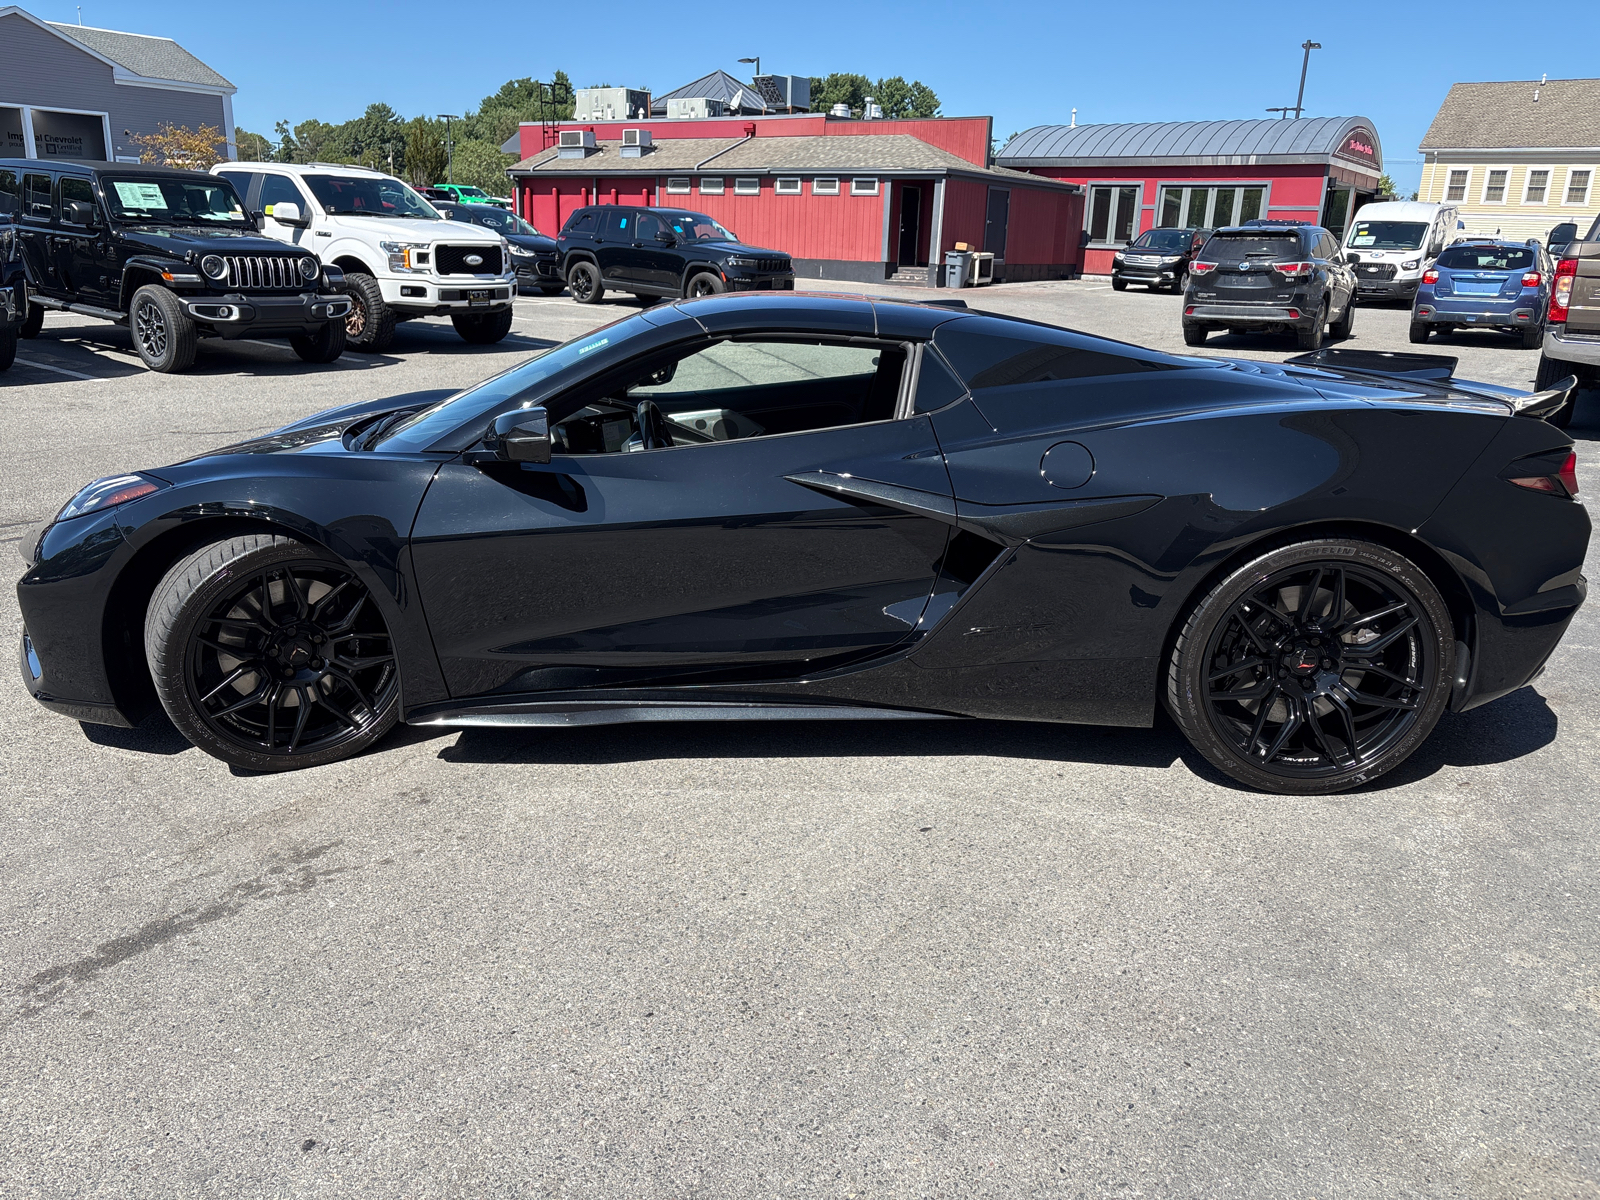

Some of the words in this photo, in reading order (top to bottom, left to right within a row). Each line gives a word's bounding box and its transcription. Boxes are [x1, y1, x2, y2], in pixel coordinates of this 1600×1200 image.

[44, 134, 83, 145] Chevrolet
[1285, 546, 1352, 560] MICHELIN
[223, 715, 261, 736] CORVETTE
[1276, 755, 1319, 763] CORVETTE
